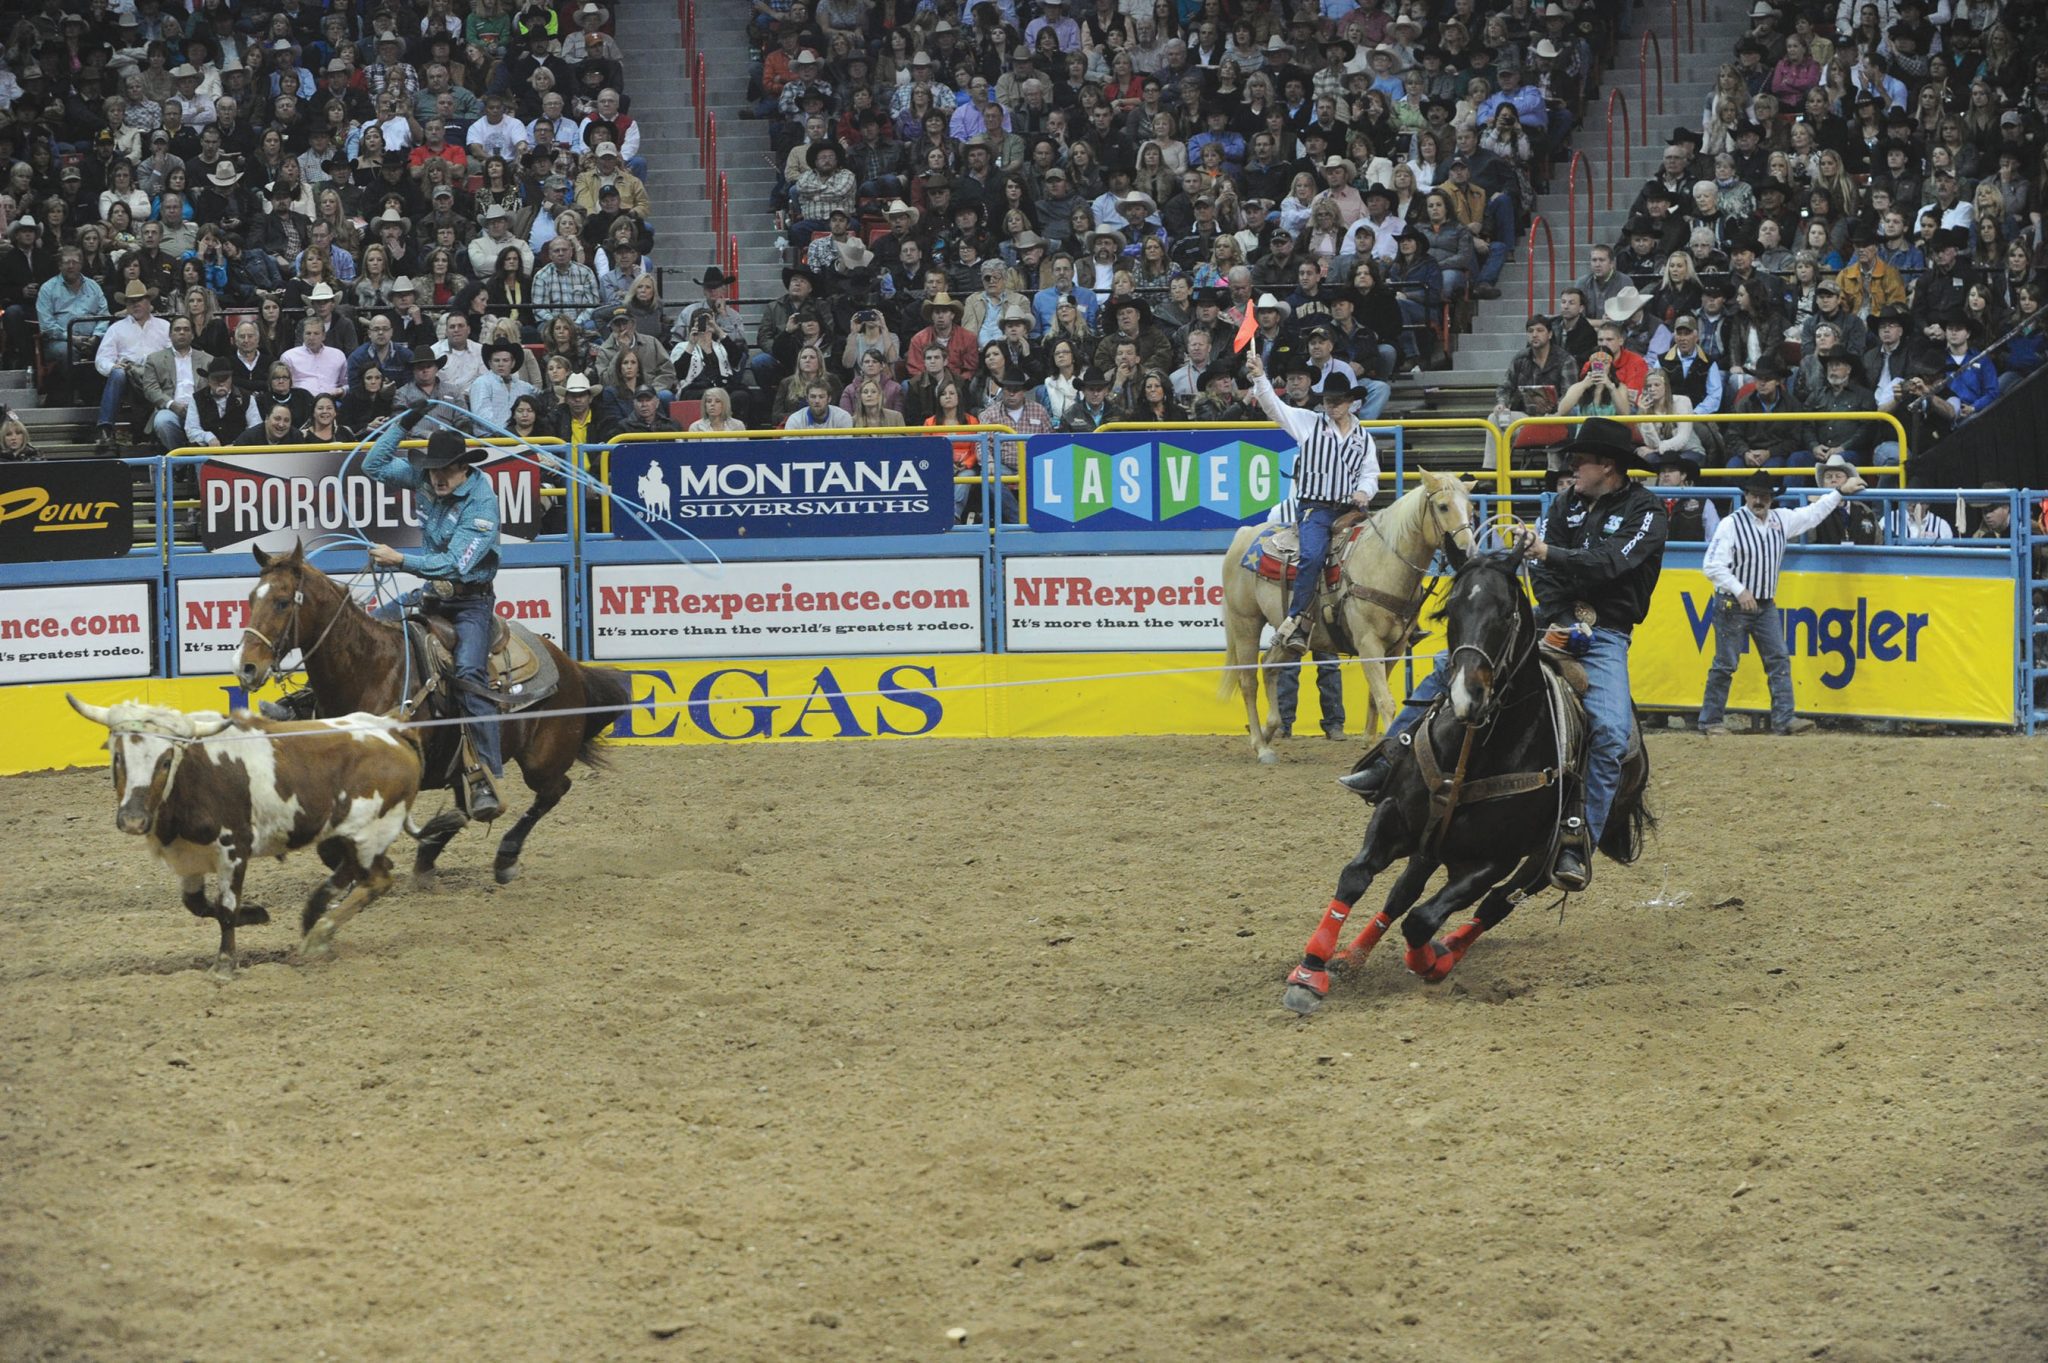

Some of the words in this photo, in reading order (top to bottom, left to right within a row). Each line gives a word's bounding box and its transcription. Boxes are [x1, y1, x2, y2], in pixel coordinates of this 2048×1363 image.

[680, 460, 928, 496] MONTANA
[1043, 456, 1141, 504] LAS
[679, 499, 930, 518] SILVERSMITHS
[599, 582, 970, 620] NFRexperience.com
[0, 613, 141, 639] nce.com
[598, 626, 627, 637] It's
[630, 627, 679, 636] more
[683, 625, 727, 635] than
[731, 624, 762, 634] the
[766, 623, 831, 634] world's
[835, 621, 914, 635] greatest
[917, 620, 974, 632] rodeo.
[1012, 618, 1041, 628] It's
[1044, 619, 1092, 628] more
[1096, 618, 1140, 628] than
[1144, 617, 1174, 627] the
[19, 648, 90, 663] greatest
[93, 646, 144, 657] rodeo.
